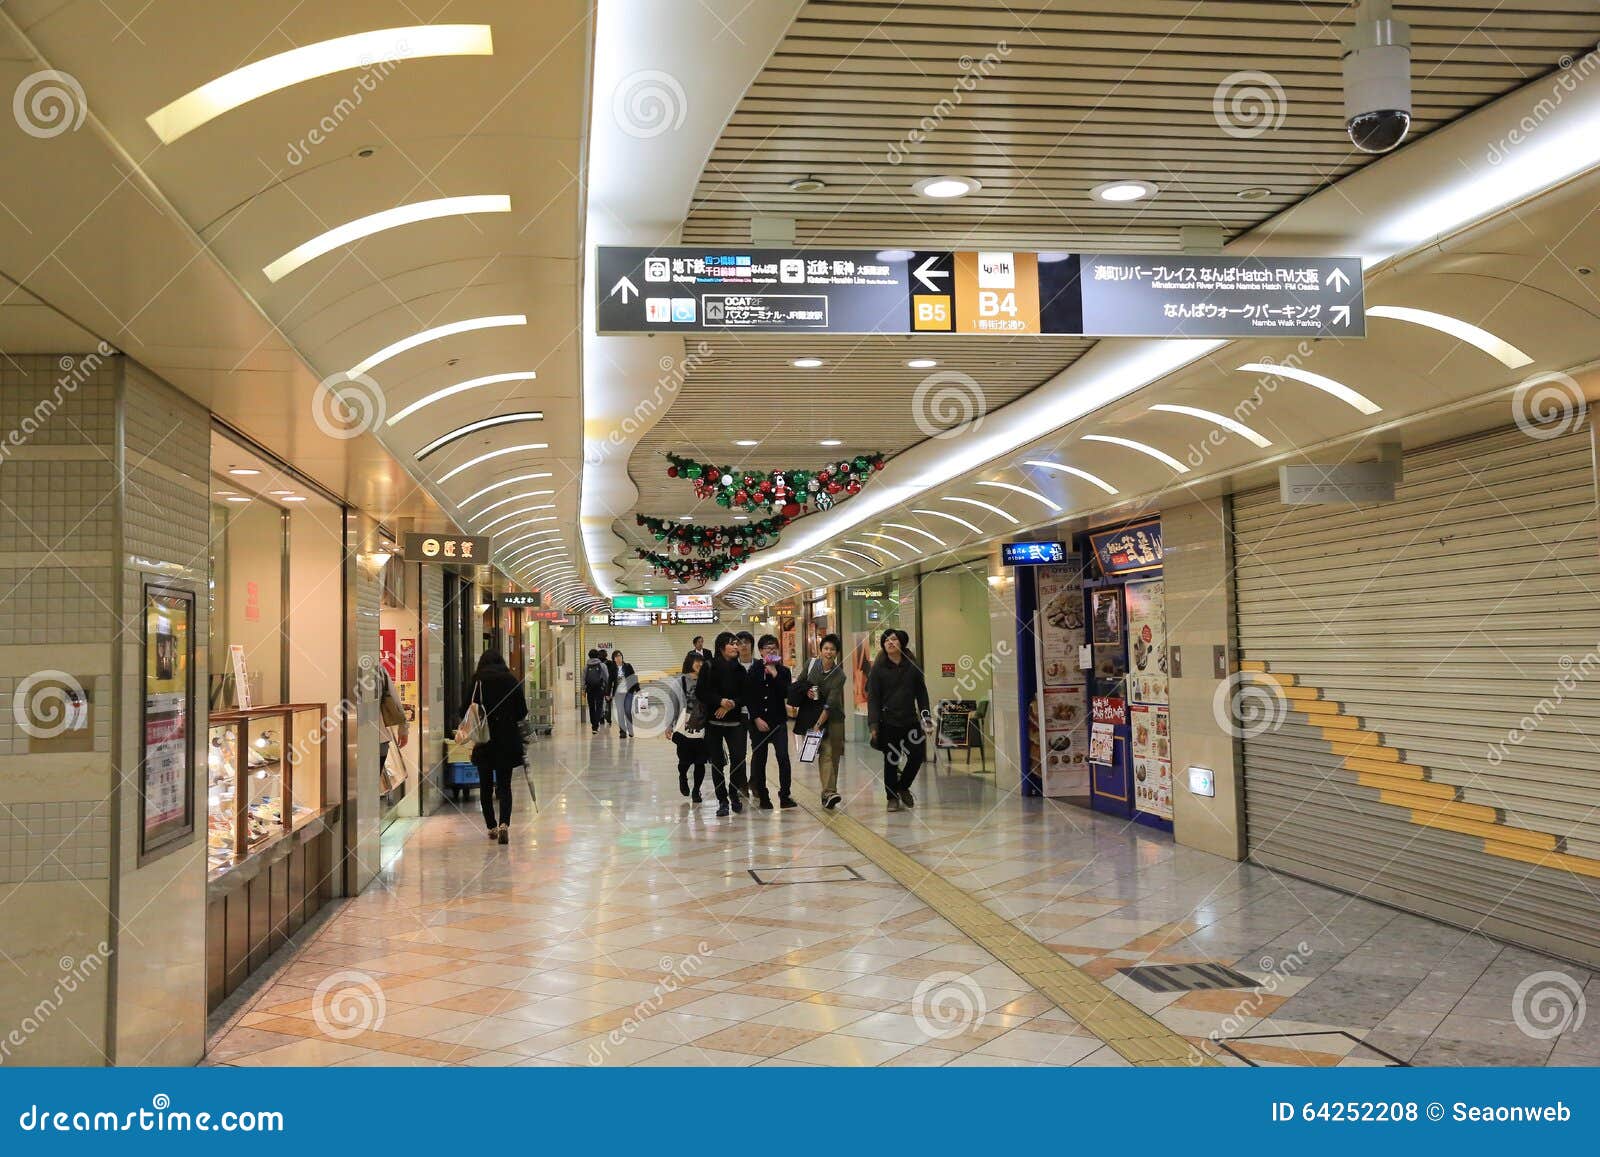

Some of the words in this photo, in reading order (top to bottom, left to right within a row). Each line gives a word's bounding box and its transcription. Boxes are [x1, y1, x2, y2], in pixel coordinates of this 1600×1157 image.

[672, 258, 705, 274] 地下鉄
[1200, 266, 1273, 282] なんばHatch
[918, 303, 946, 321] B5
[979, 291, 1018, 317] B4
